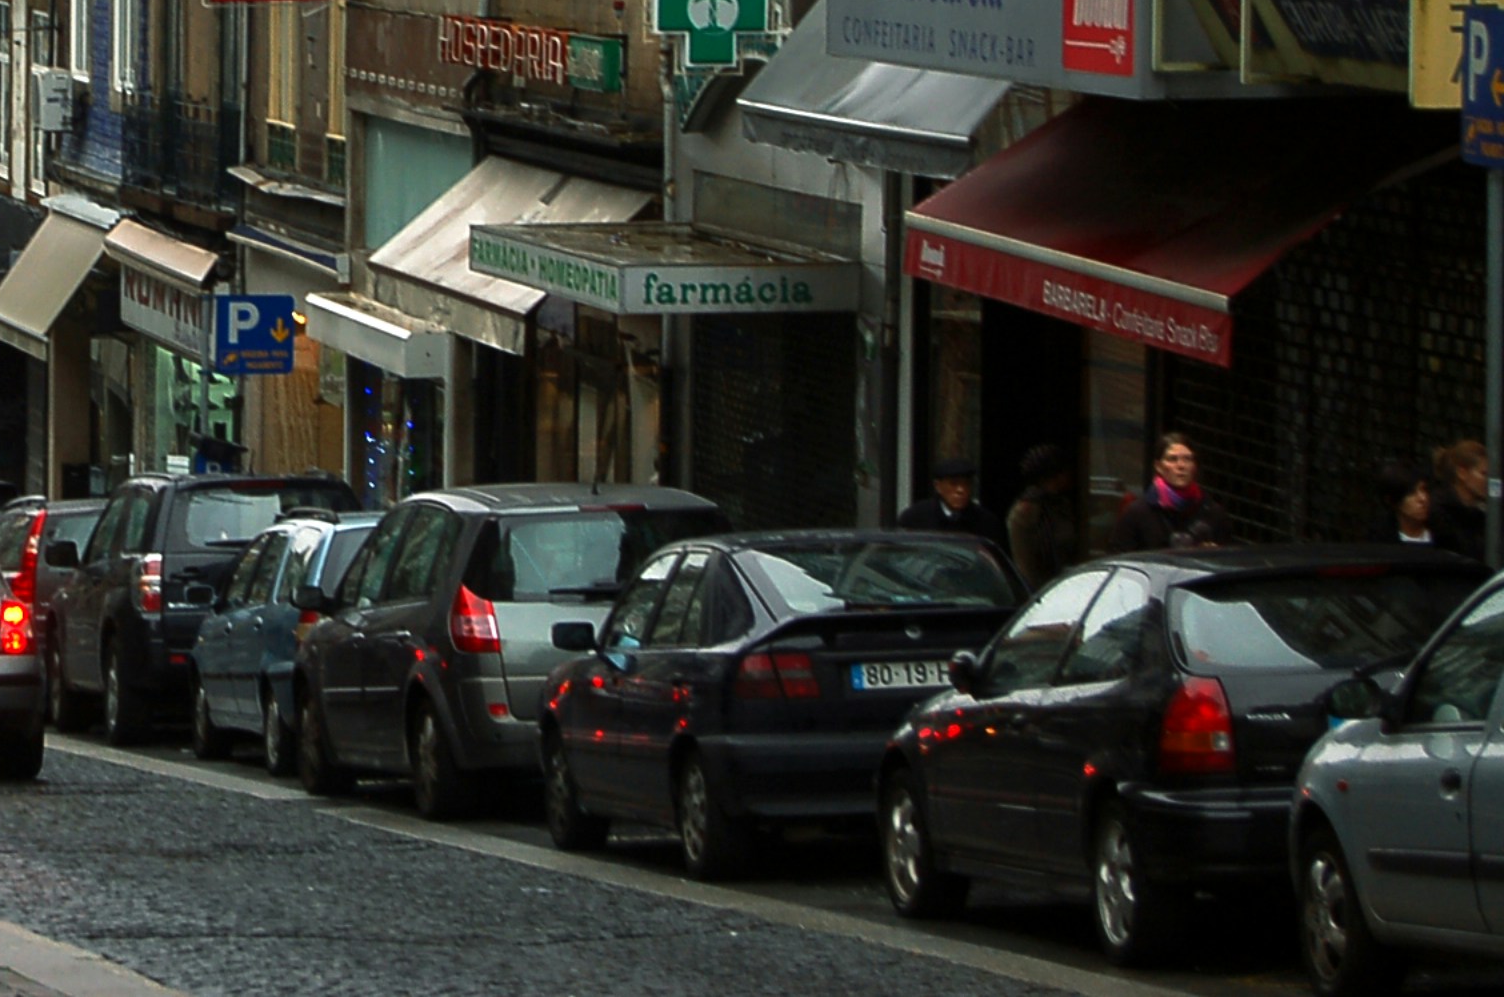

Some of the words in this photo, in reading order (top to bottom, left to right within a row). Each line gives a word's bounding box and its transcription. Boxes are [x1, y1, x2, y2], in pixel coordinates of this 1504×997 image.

[438, 15, 563, 86] HOSPEDARIA
[842, 15, 936, 53] CONFEITARIA
[949, 28, 1036, 67] SNACK-BAR
[1468, 19, 1489, 102] P
[538, 255, 618, 301] HOMEOPATIA
[643, 272, 814, 305] farmácia
[228, 302, 260, 344] P
